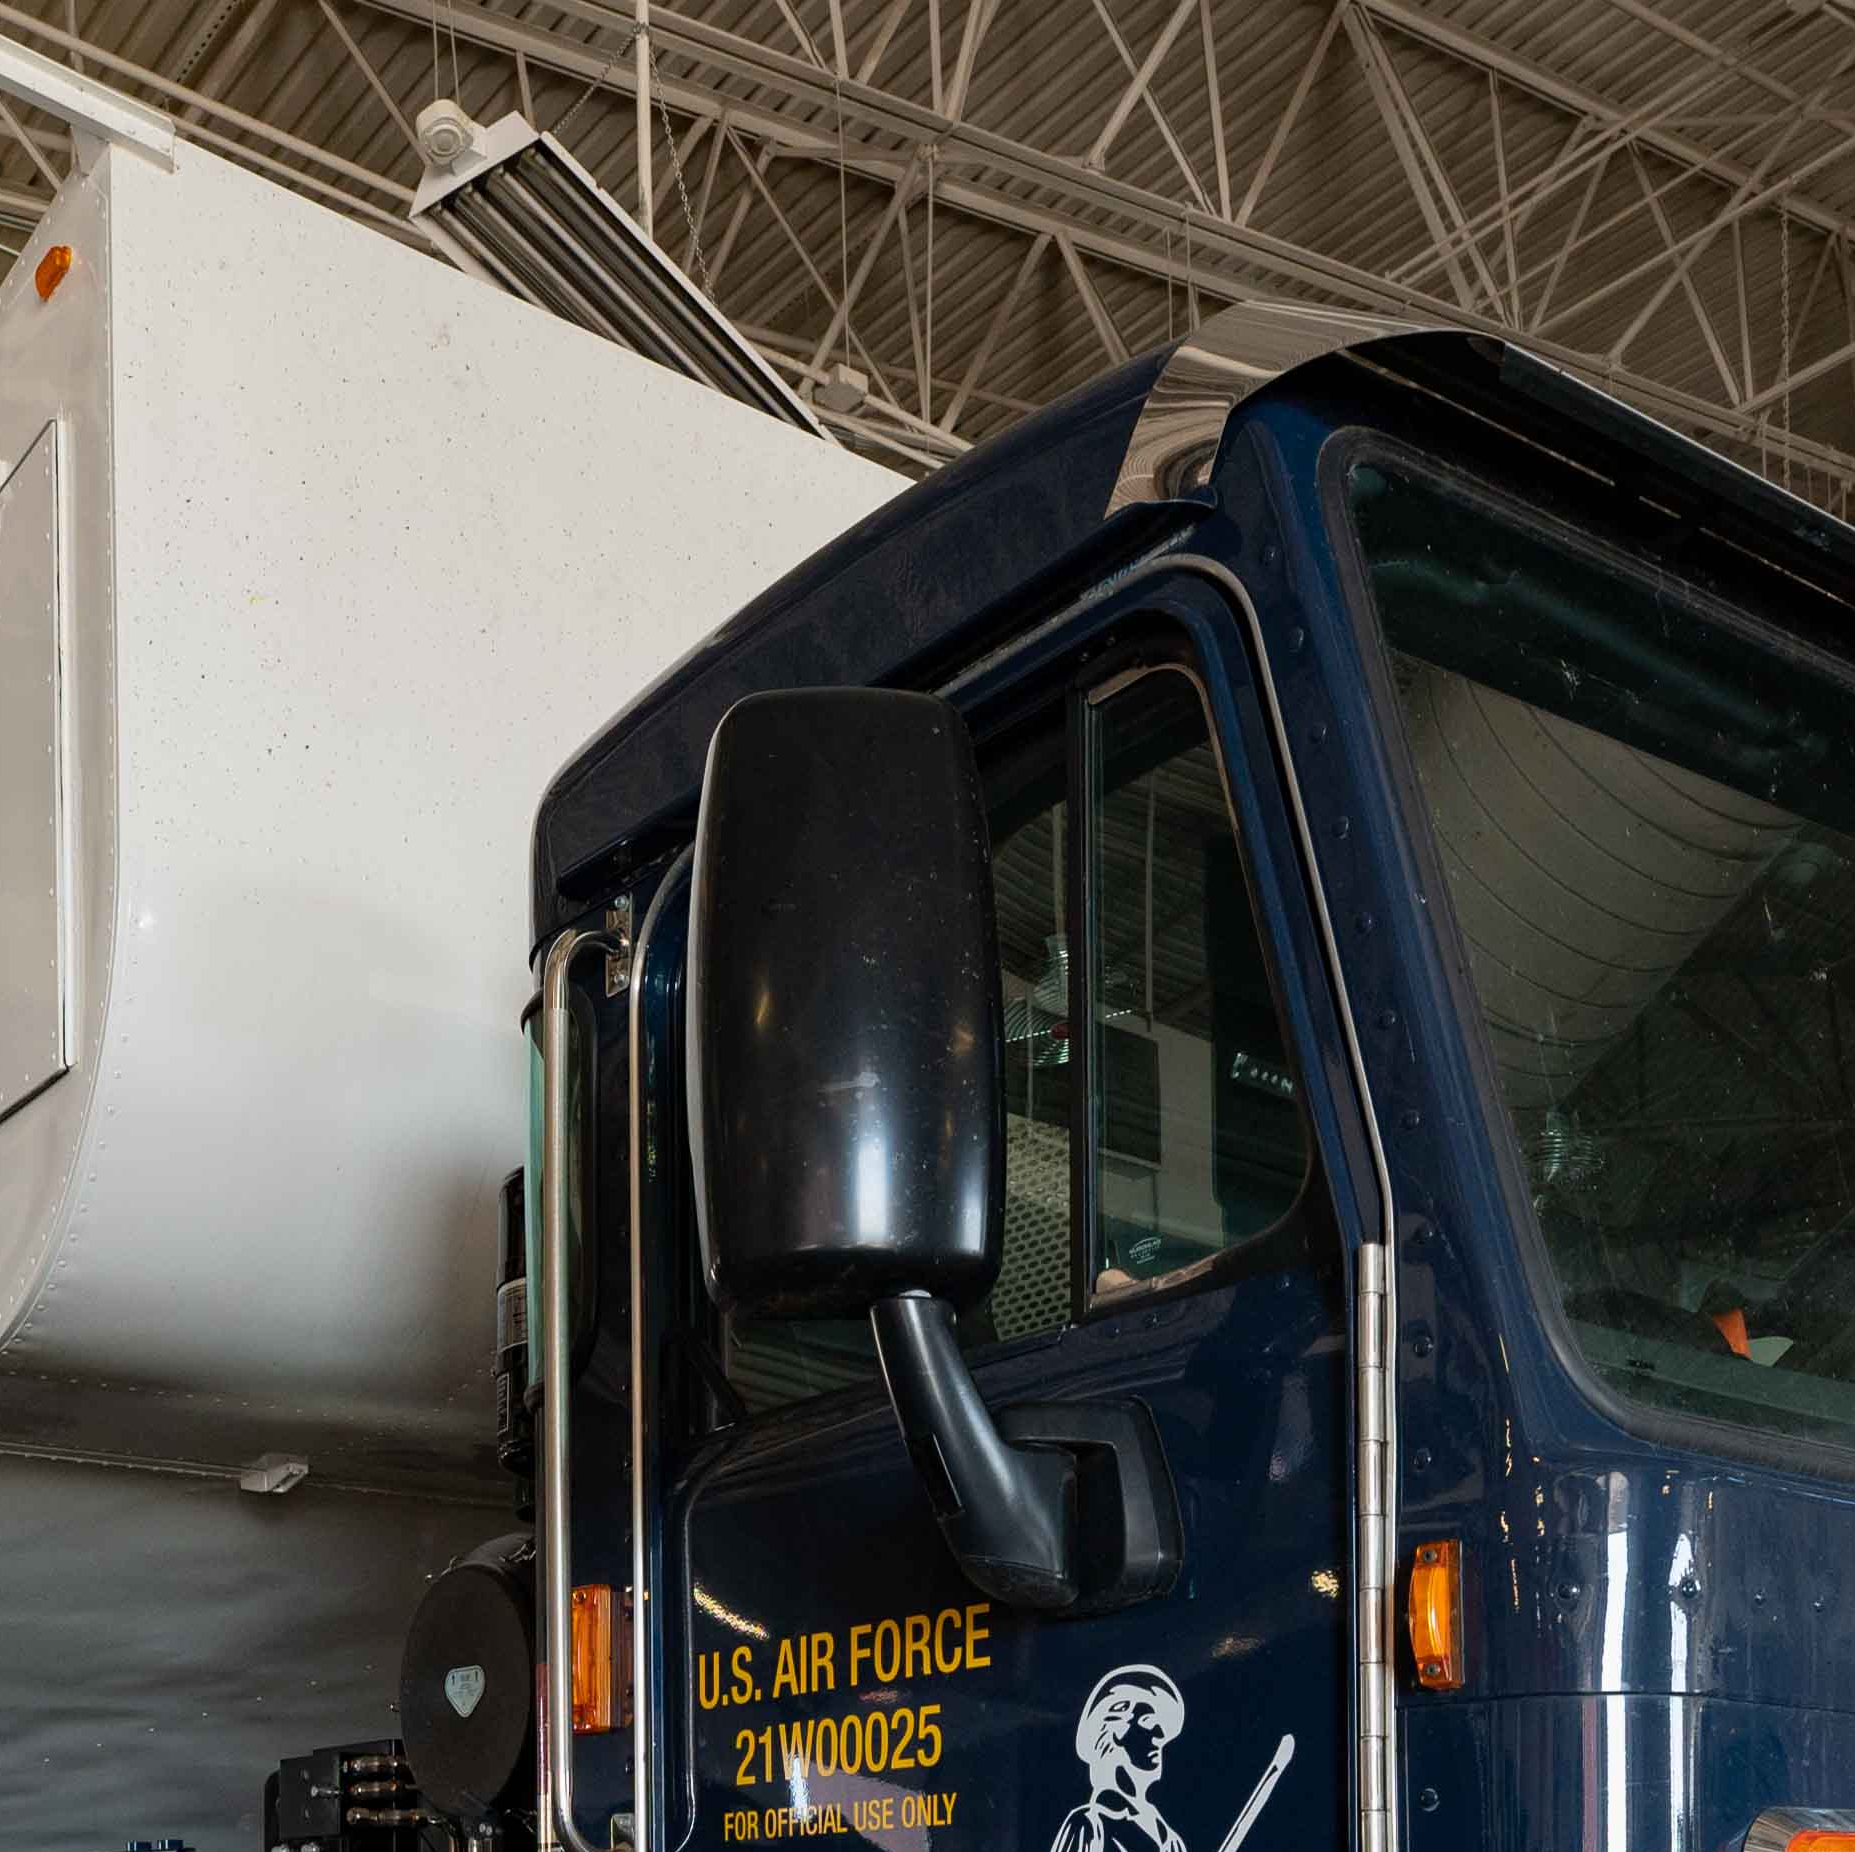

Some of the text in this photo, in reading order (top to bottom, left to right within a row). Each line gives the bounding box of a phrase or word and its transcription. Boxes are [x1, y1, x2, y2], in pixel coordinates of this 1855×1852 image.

[698, 1603, 992, 1710] U.S. AIR FORCE
[735, 1703, 943, 1787] 21W00025
[724, 1792, 958, 1841] FOR OFFICIAL USE ONLY
